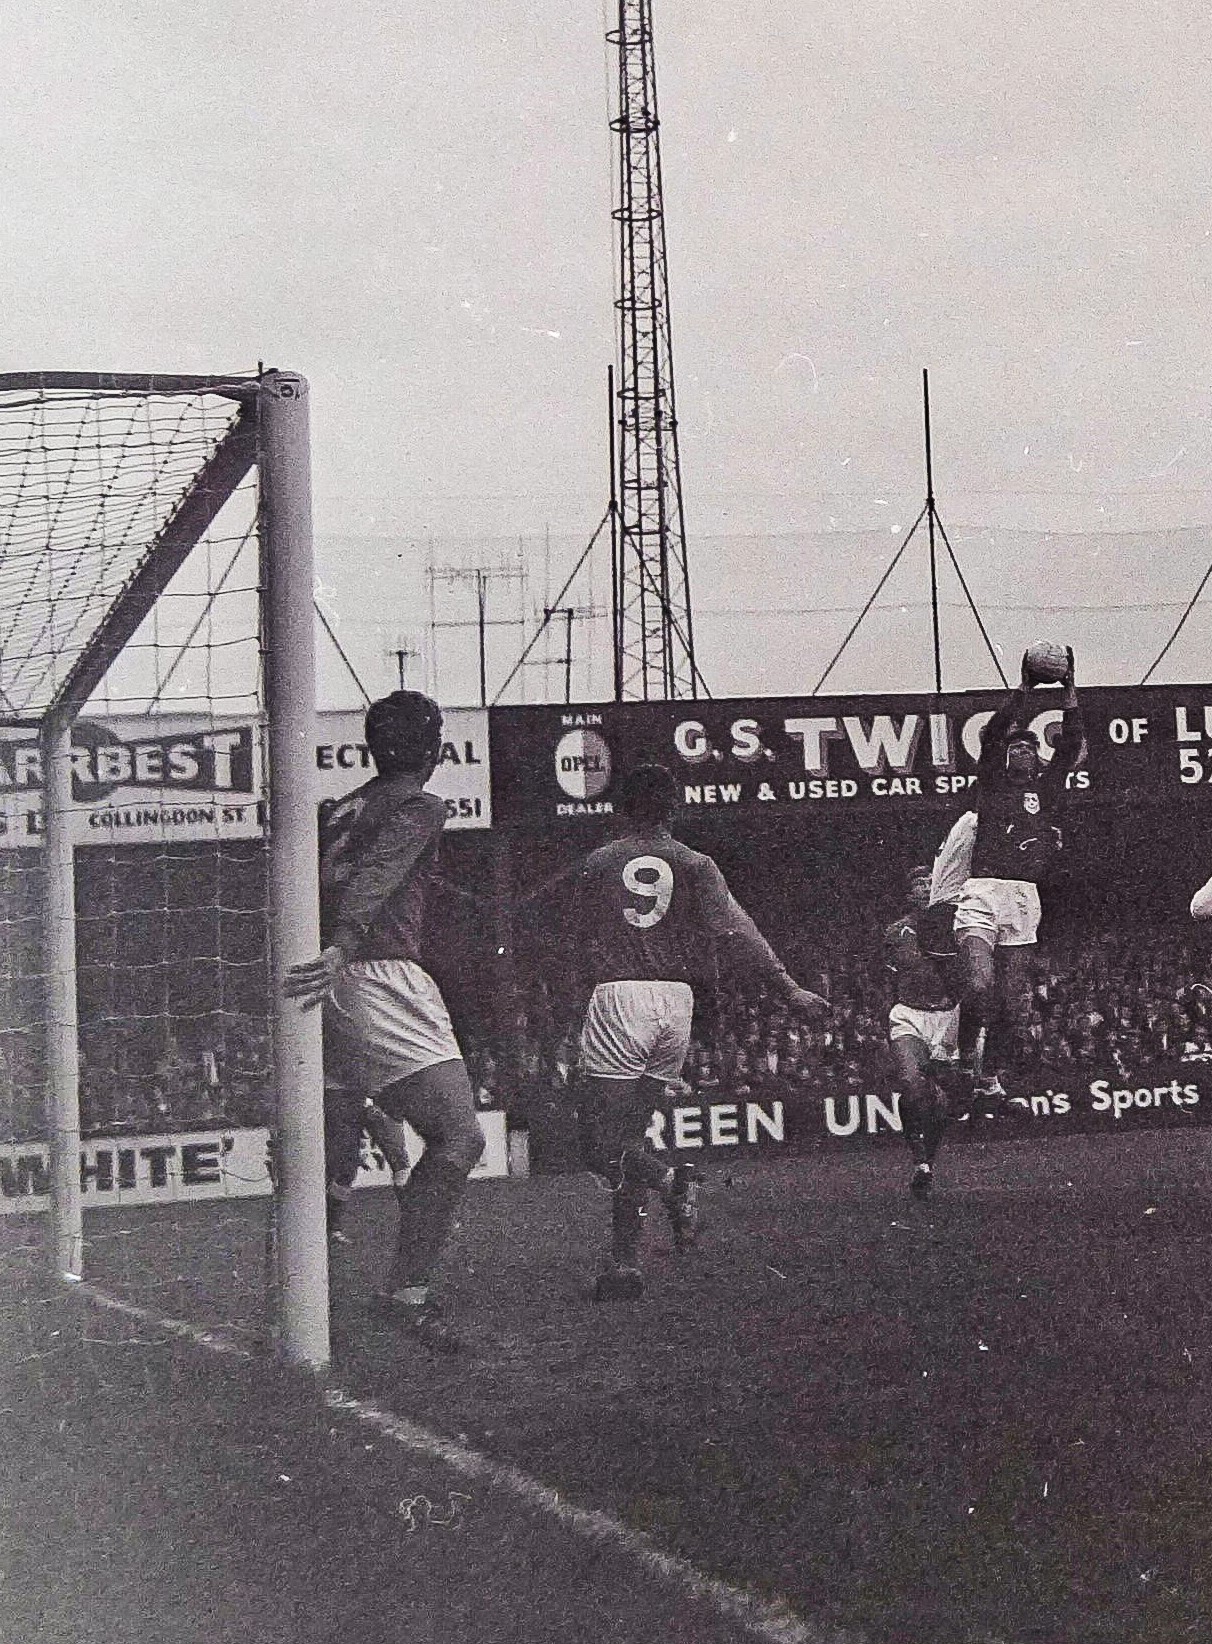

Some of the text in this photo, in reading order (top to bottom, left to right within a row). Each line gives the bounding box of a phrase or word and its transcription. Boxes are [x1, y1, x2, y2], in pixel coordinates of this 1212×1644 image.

[561, 713, 602, 725] MAIN
[1109, 718, 1149, 744] OF
[684, 783, 742, 804] NEW
[757, 782, 776, 801] &
[788, 779, 858, 799] USED
[871, 777, 923, 796] CAR
[556, 802, 614, 816] DEALER
[622, 855, 674, 929] 9
[1090, 1079, 1199, 1119] Sports
[645, 1092, 902, 1150] REEN UN
